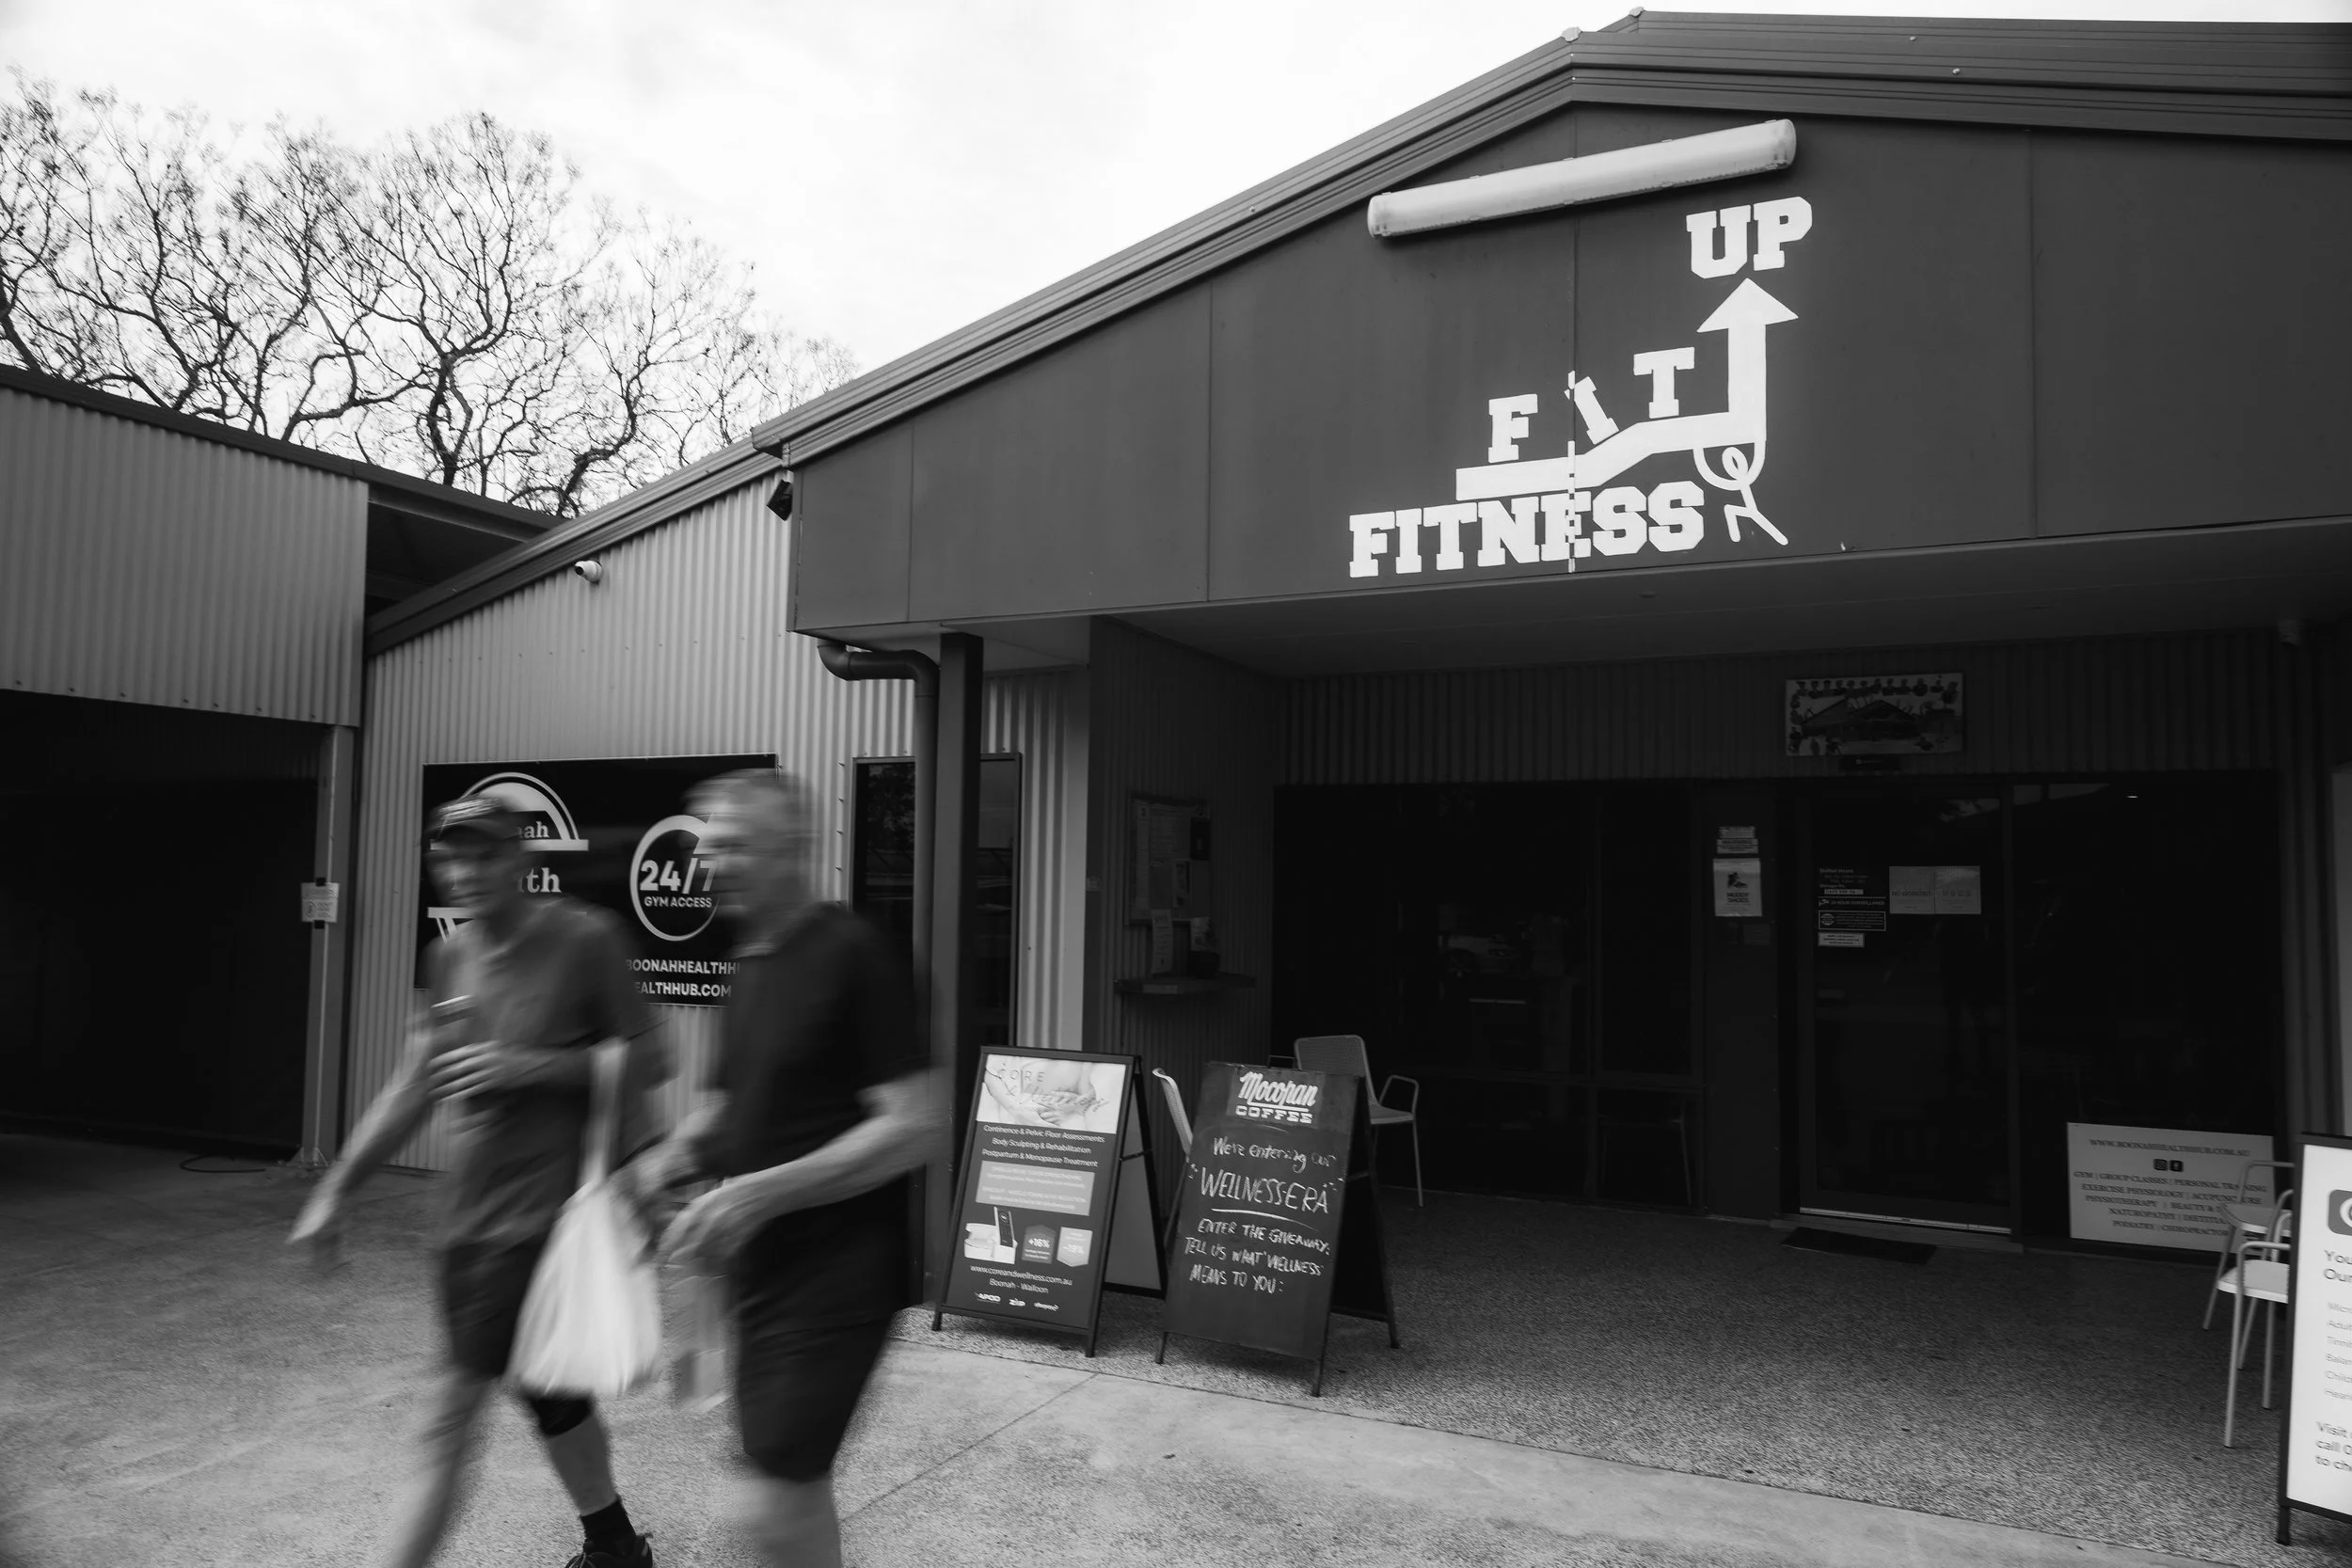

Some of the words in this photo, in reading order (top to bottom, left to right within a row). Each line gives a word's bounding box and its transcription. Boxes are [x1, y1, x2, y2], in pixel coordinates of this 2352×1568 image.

[1686, 196, 1813, 278] UP
[1349, 481, 1704, 578] FITNESS
[640, 857, 718, 895] 24/7
[644, 895, 669, 908] GYM
[670, 896, 713, 909] ACCESS
[1238, 1071, 1319, 1108] Mocopan
[1235, 1105, 1314, 1124] COFFEE
[992, 1137, 1009, 1148] Body
[1009, 1139, 1040, 1150] Sculpting
[1045, 1143, 1092, 1154] Rehabilitation
[1025, 1129, 1044, 1137] Pelvic
[1044, 1131, 1061, 1139] Floor
[1061, 1132, 1105, 1144] Assessments
[981, 1148, 1019, 1159] Postpartum
[1025, 1153, 1063, 1164] Menopause
[1063, 1157, 1099, 1167] Treatment
[2099, 1173, 2129, 1181] GROUP
[2130, 1176, 2169, 1184] CLASSES
[2174, 1180, 2221, 1189] PERSONAL
[2081, 1183, 2124, 1194] EXERCISE
[2126, 1187, 2184, 1198] PHYSIOLOGY
[2085, 1196, 2157, 1207] PHYSIOTHERAPY
[1198, 1218, 1238, 1234] ENTER
[1242, 1224, 1271, 1241] THE
[1184, 1236, 1207, 1255] TELL
[1210, 1243, 1227, 1261] US
[1232, 1249, 1263, 1266] WHAT
[1189, 1264, 1228, 1286] MEANS
[1232, 1271, 1248, 1288] TO
[989, 1277, 1016, 1289] Boonah
[1021, 1282, 1050, 1294] Walloon
[2315, 1420, 2348, 1438] Visit
[2315, 1440, 2341, 1453] call
[2314, 1456, 2331, 1467] to
